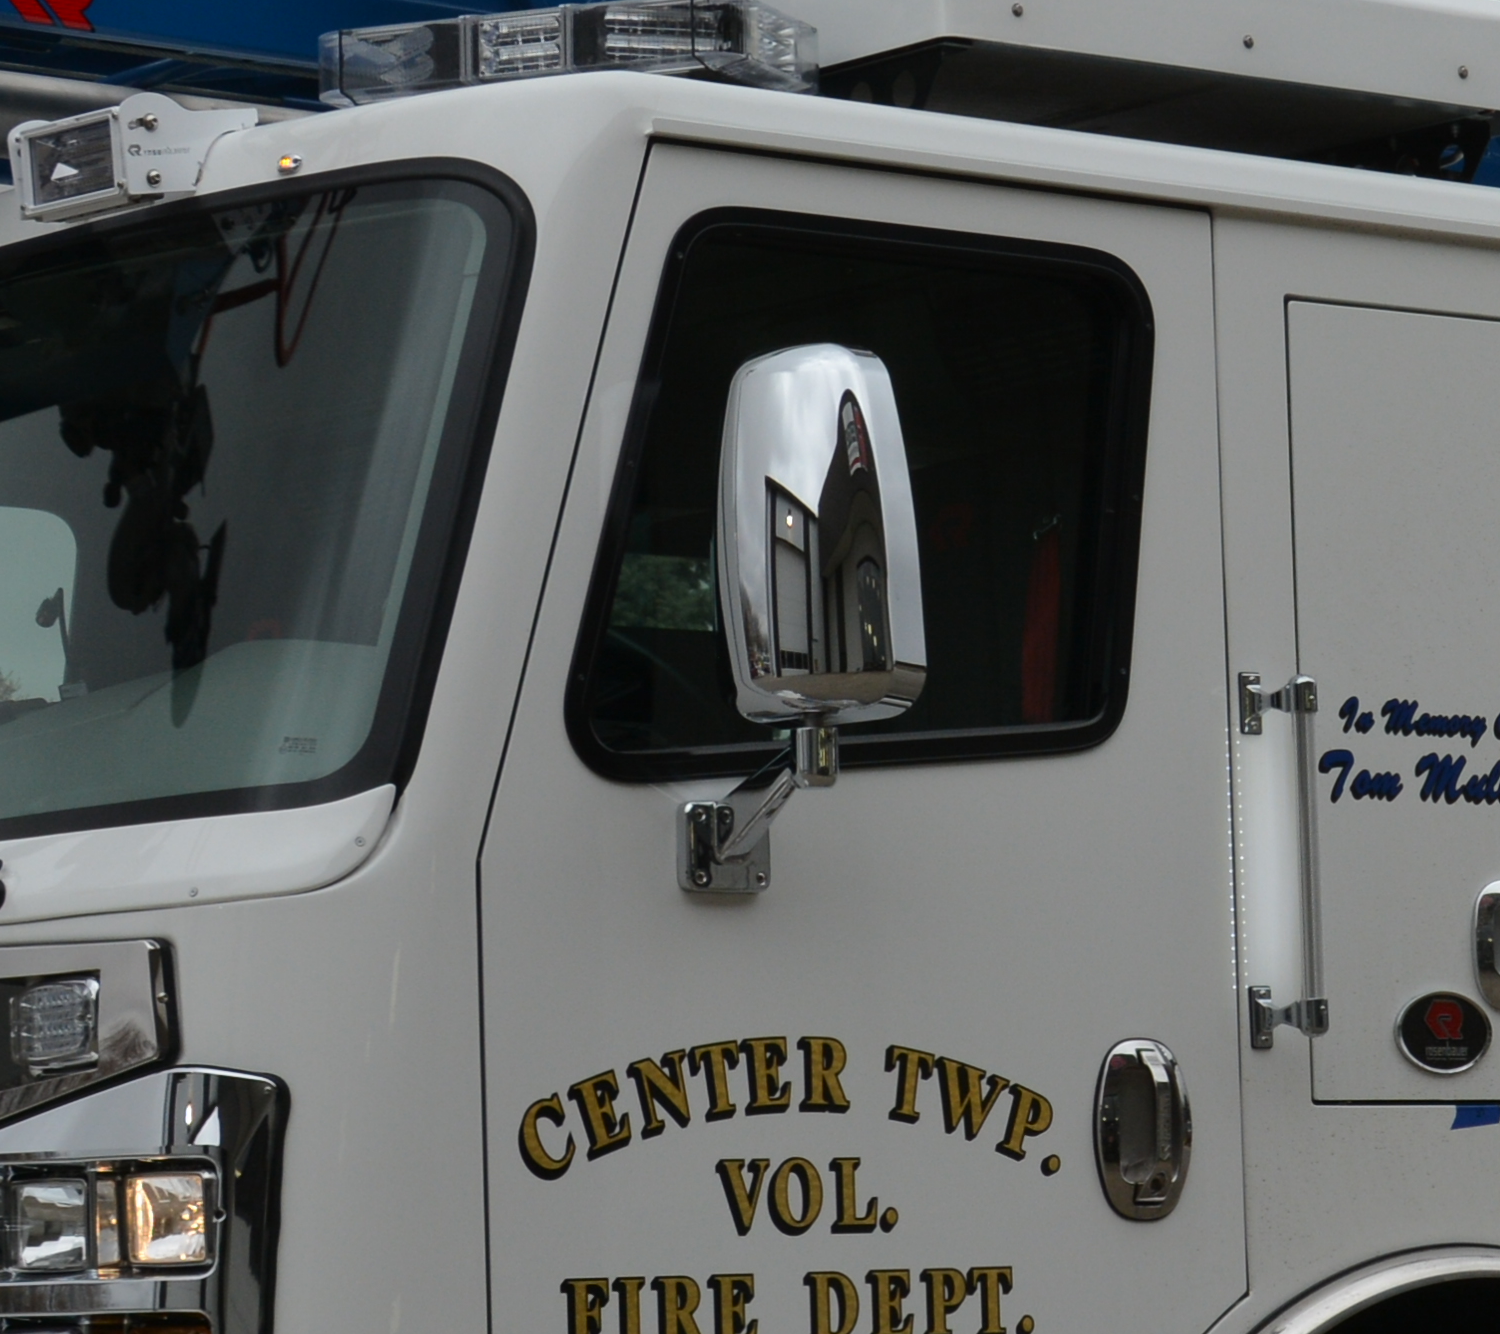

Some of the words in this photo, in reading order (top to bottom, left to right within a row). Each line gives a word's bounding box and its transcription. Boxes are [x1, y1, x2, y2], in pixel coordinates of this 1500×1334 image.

[1339, 696, 1376, 735] In
[1381, 698, 1488, 749] Memory
[1318, 749, 1404, 804] Tom
[518, 1036, 852, 1181] CENTER
[884, 1043, 1062, 1176] TWP.
[715, 1157, 900, 1237] VOL.
